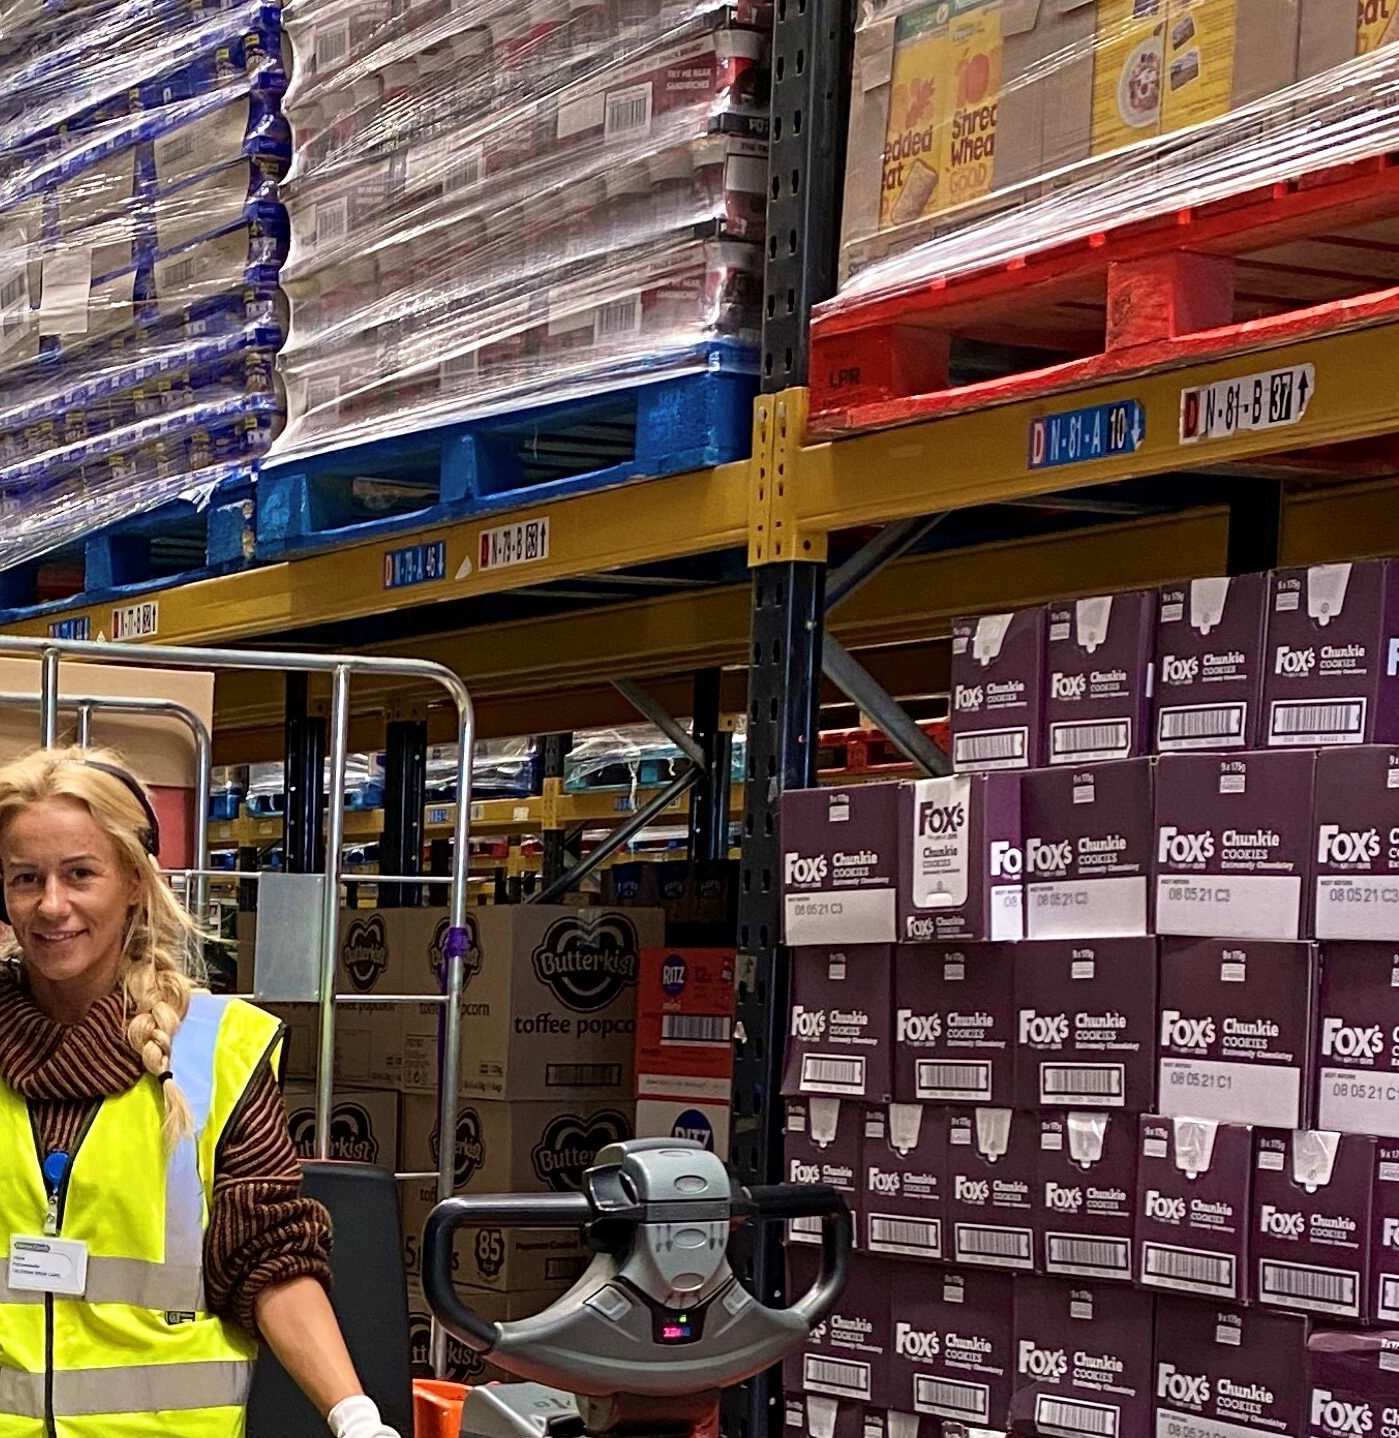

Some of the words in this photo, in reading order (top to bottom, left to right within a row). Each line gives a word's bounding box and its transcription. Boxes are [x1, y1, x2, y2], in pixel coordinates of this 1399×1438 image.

[663, 965, 685, 985] RITZ
[515, 1013, 570, 1034] toffee
[577, 1017, 637, 1038] popco
